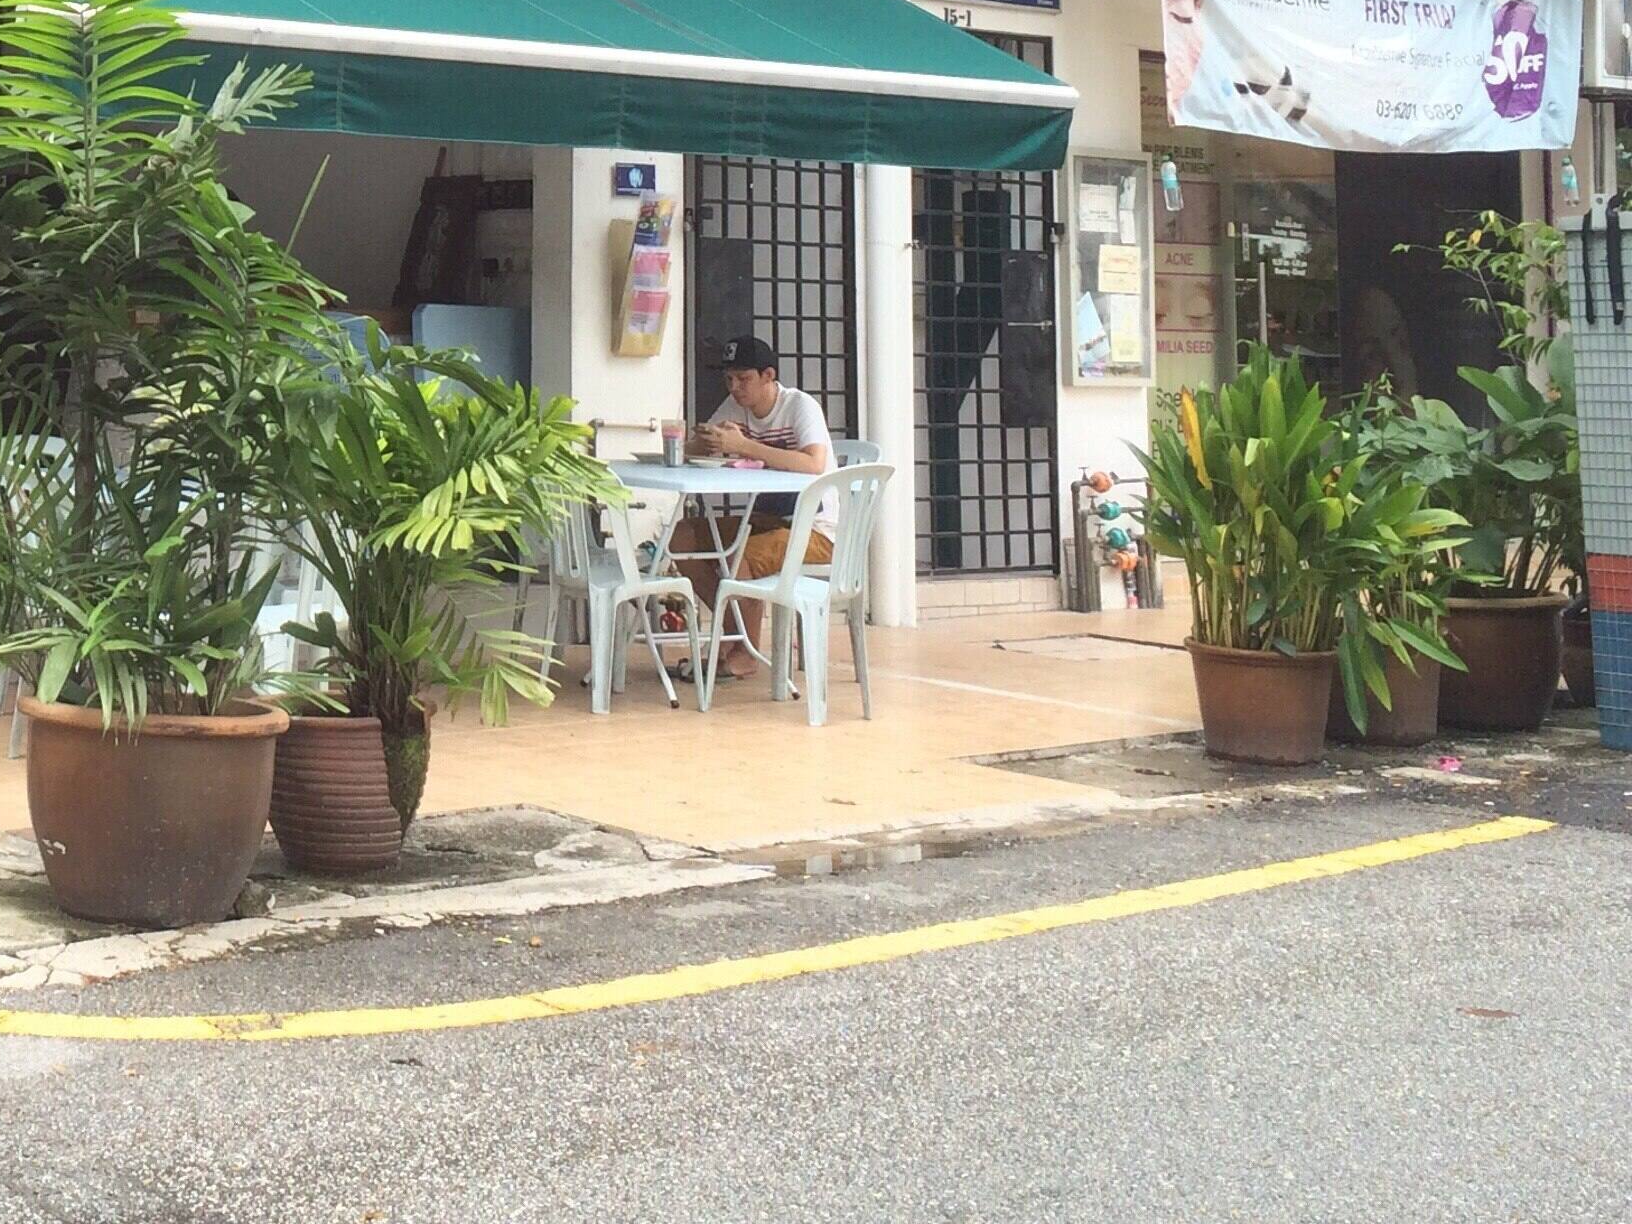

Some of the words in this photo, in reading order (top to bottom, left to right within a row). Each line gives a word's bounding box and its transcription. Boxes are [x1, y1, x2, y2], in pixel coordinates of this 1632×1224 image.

[943, 7, 972, 27] 15-1
[1164, 253, 1194, 266] ACNE
[1186, 340, 1214, 354] SEED
